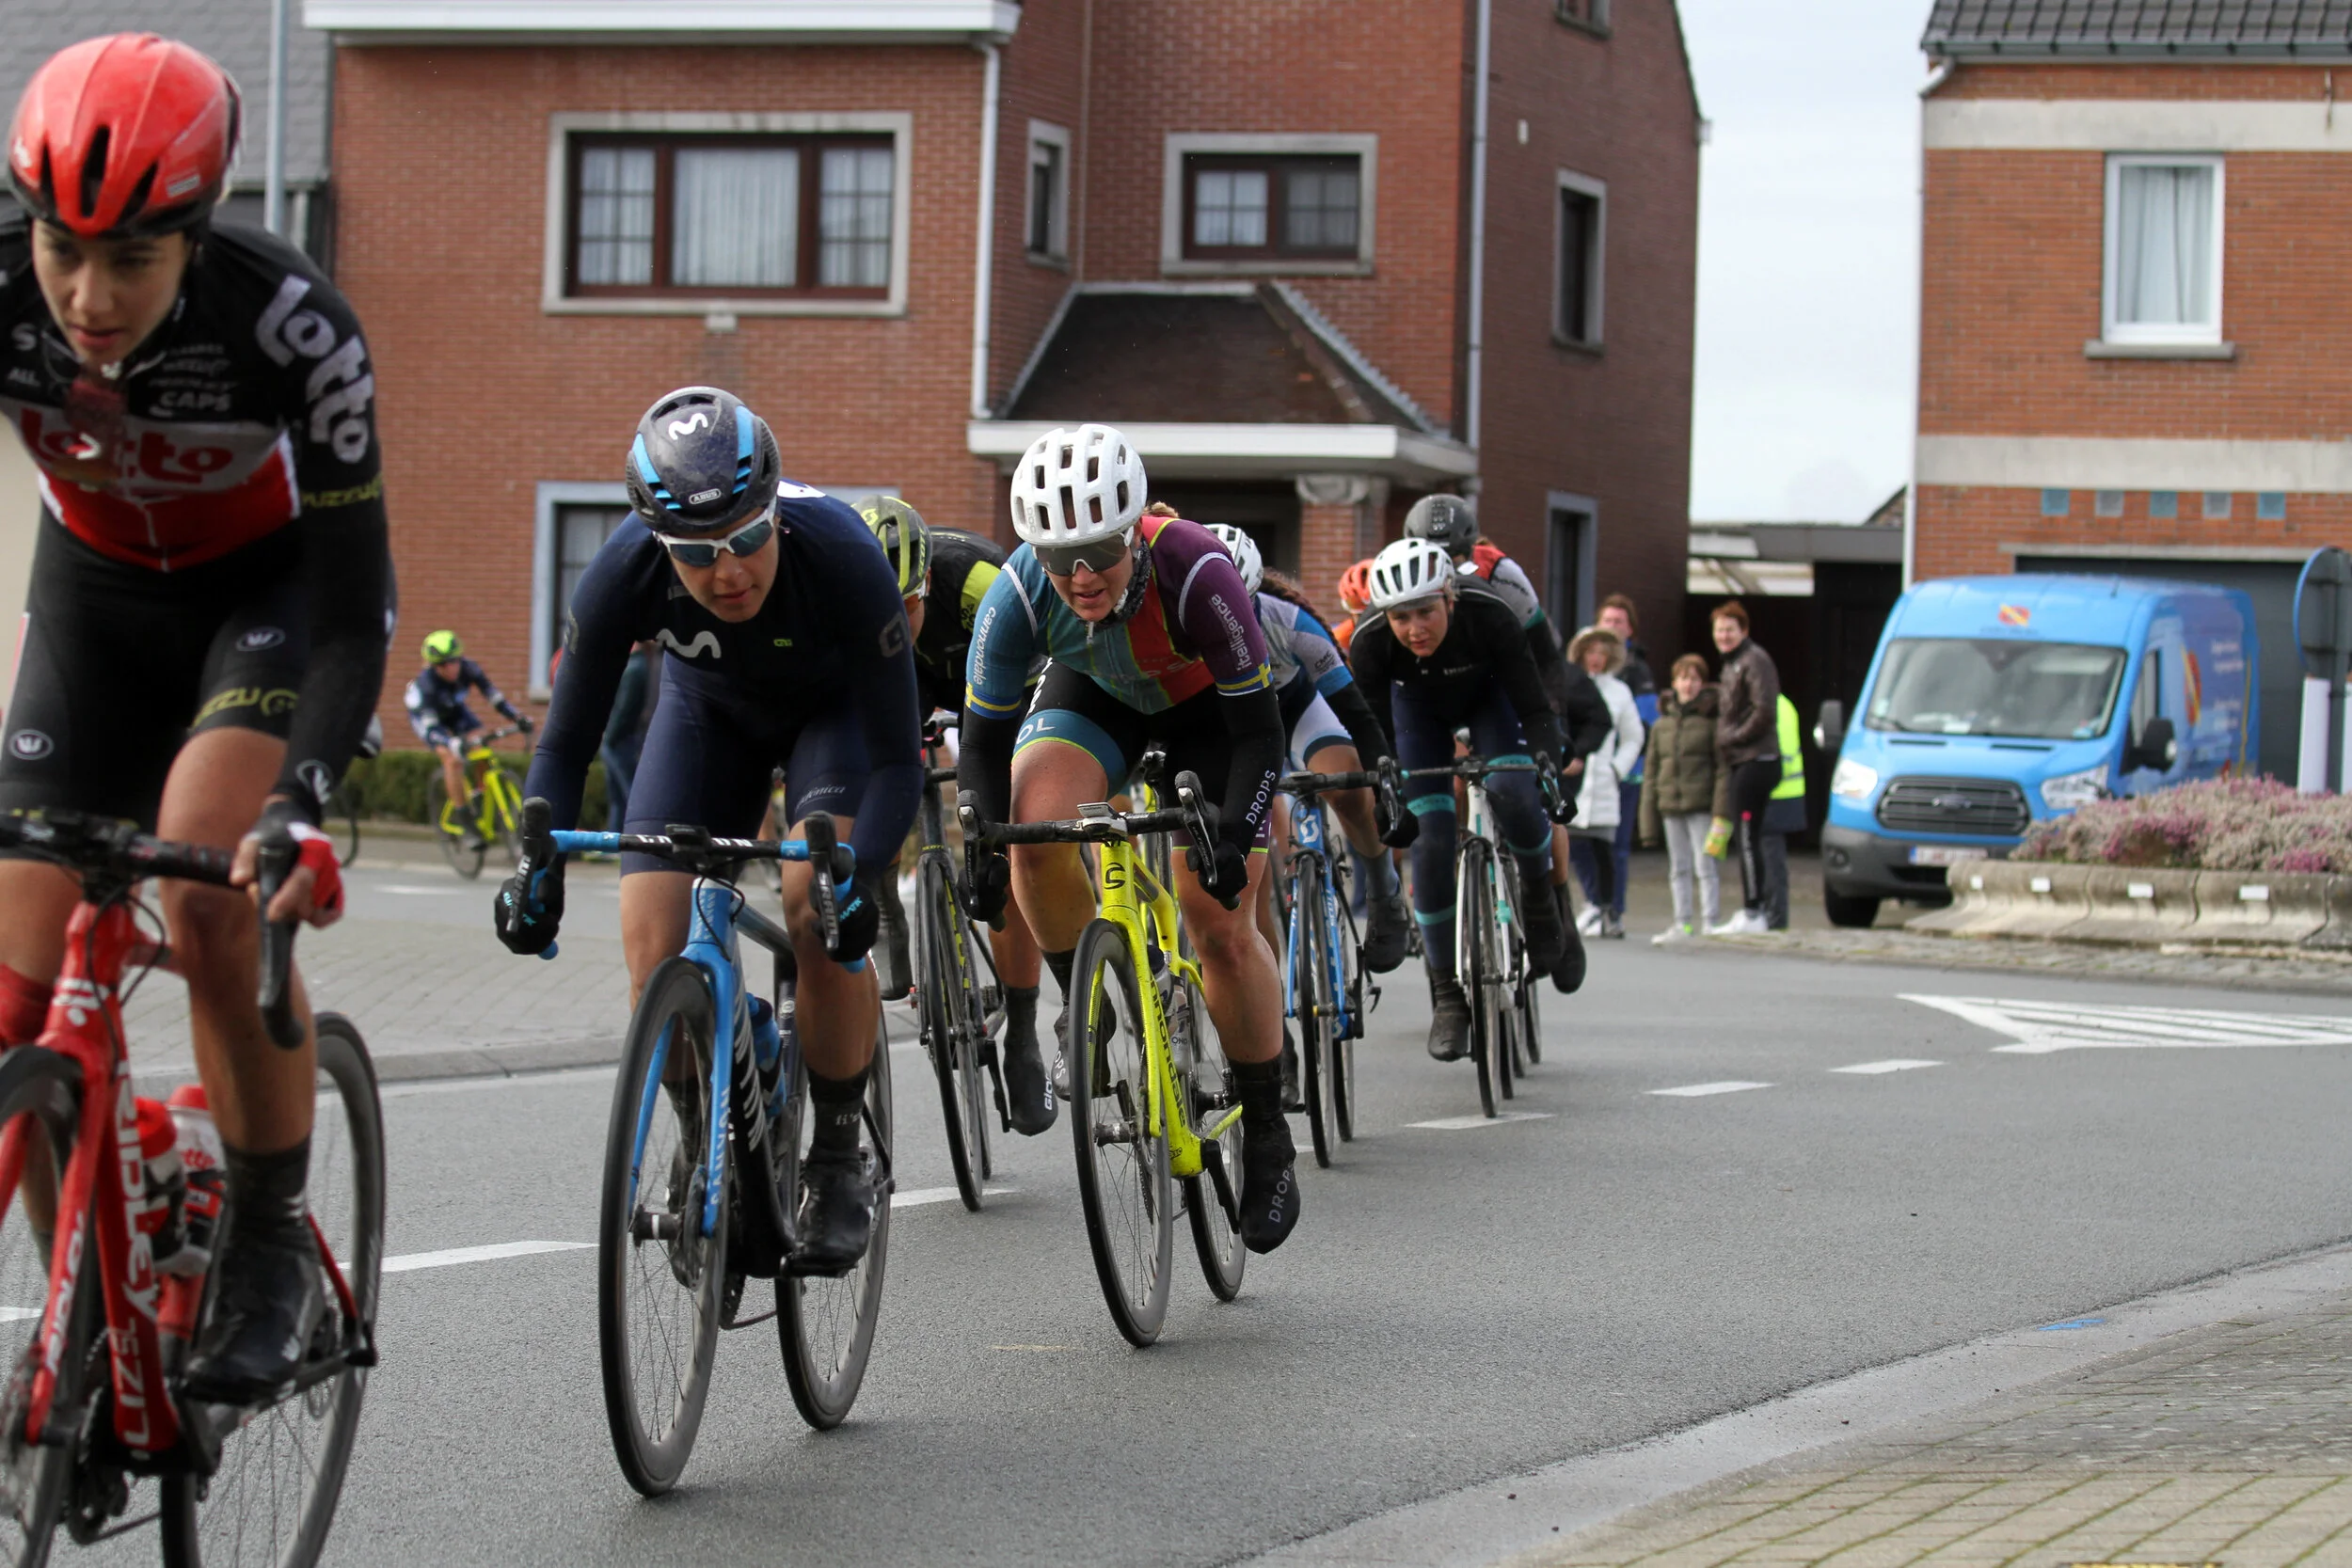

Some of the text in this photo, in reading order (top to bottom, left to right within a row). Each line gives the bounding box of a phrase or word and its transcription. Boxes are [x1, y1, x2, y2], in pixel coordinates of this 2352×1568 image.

[160, 390, 231, 412] CAPS
[256, 274, 373, 463] lotto
[692, 490, 719, 502] ABUS
[973, 607, 996, 686] cannondale
[1211, 594, 1252, 671] itelligence
[1245, 769, 1277, 825] DROPS
[1150, 974, 1186, 1128] nnondale
[115, 1060, 161, 1324] RIDLEY
[1268, 1159, 1295, 1223] DROPS
